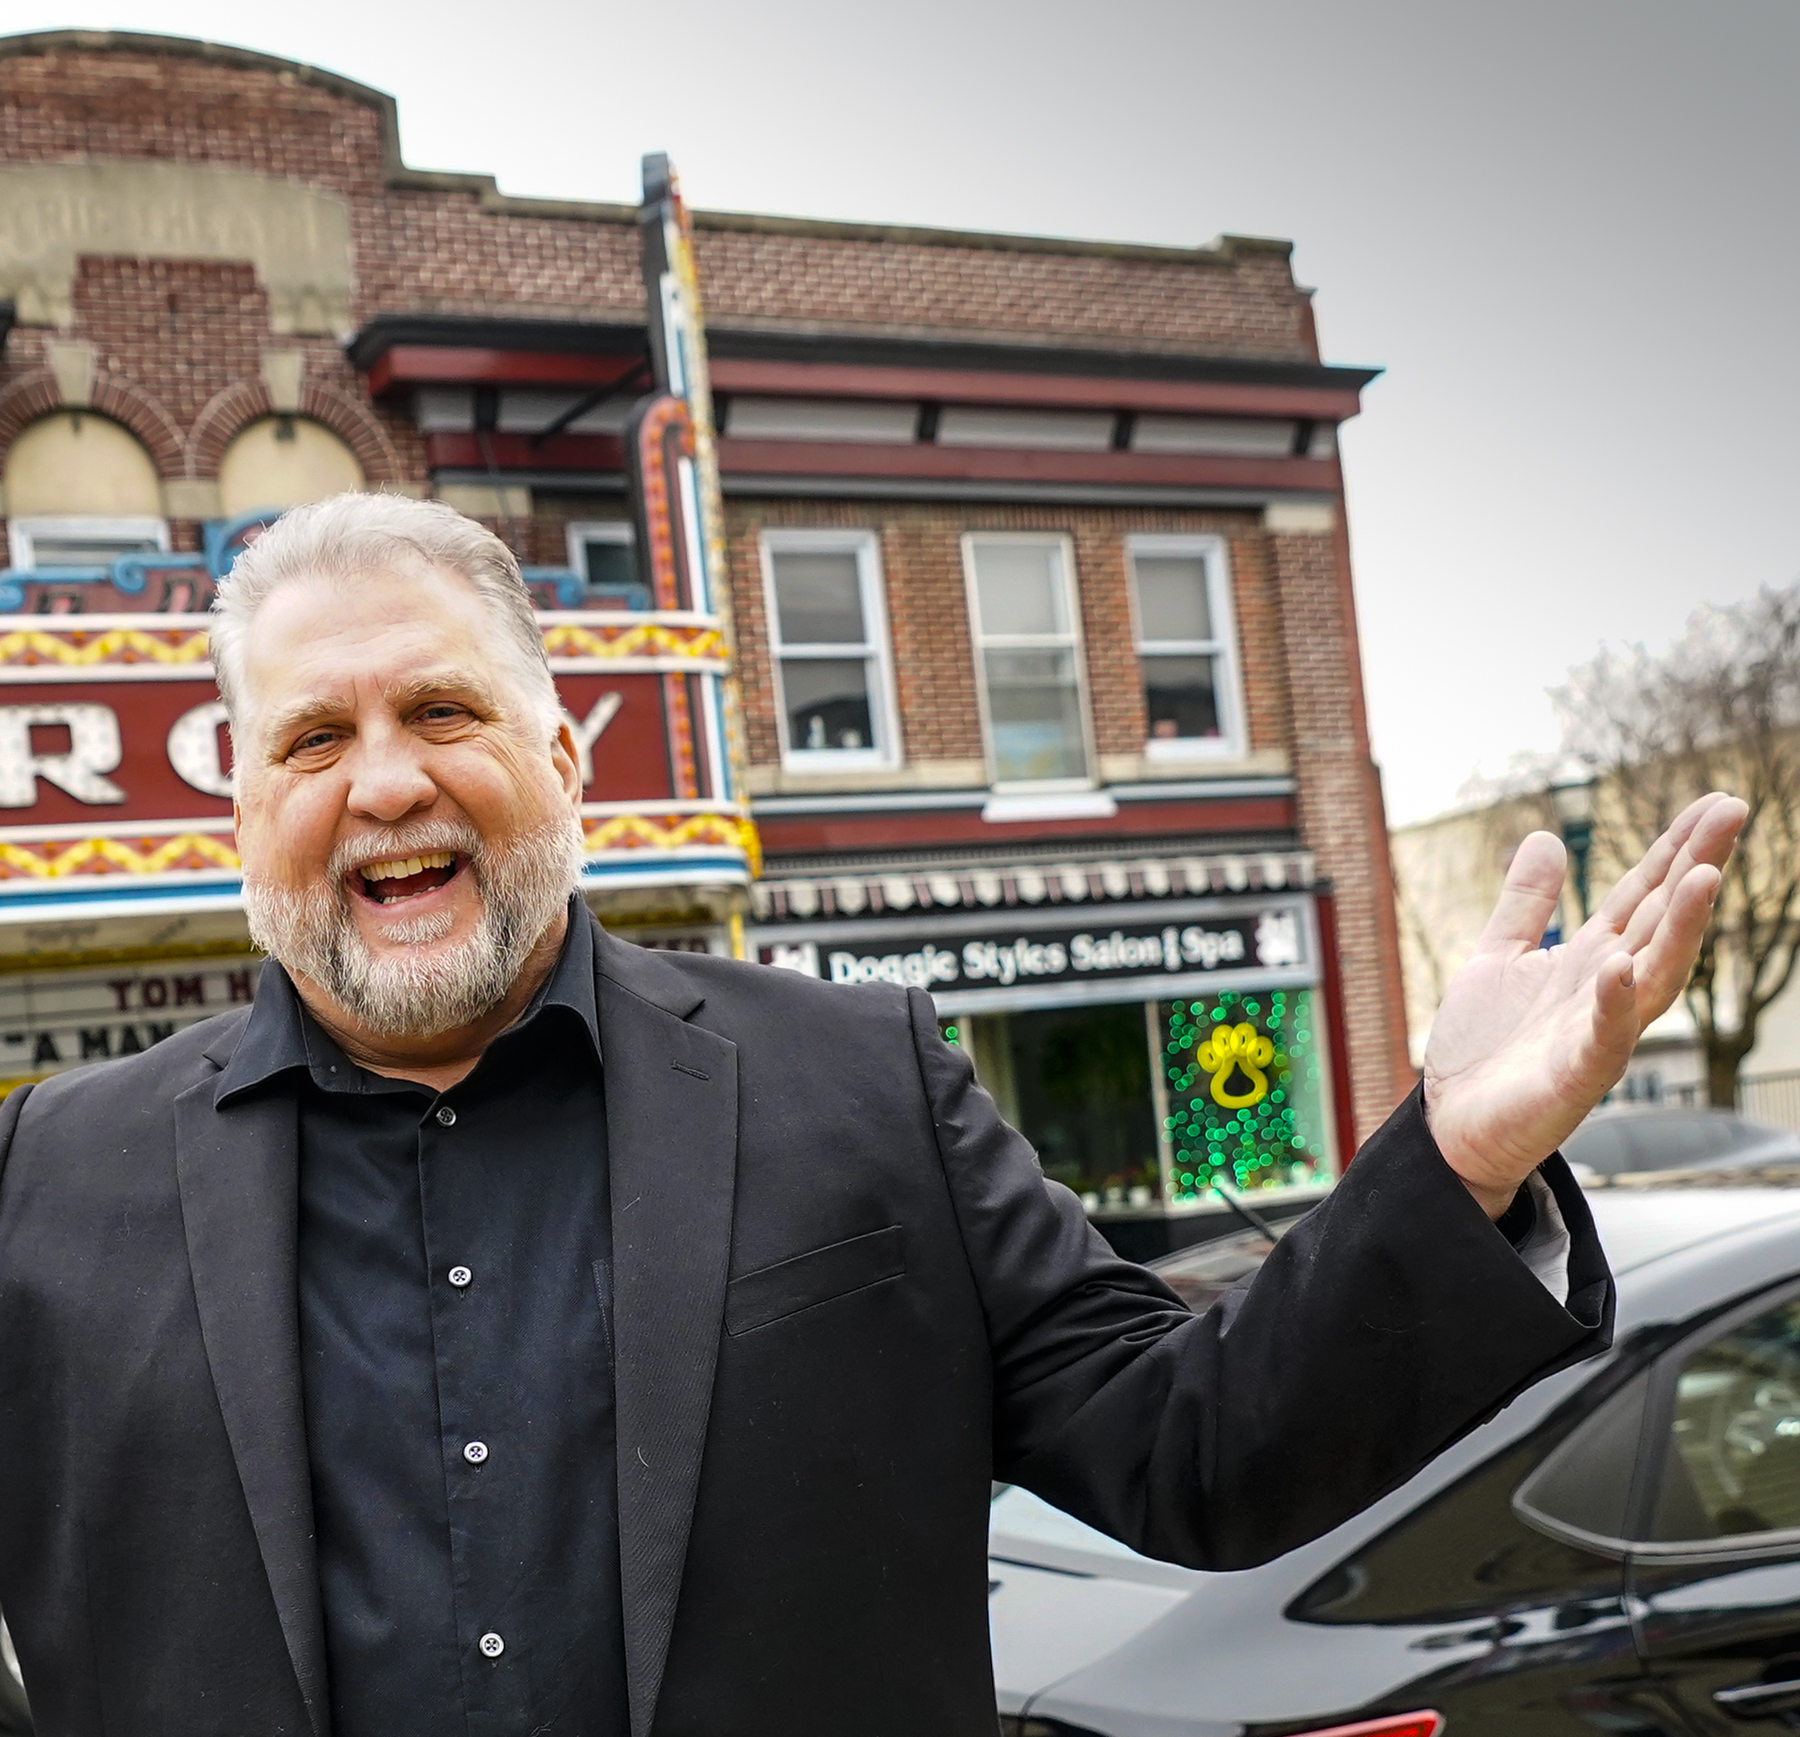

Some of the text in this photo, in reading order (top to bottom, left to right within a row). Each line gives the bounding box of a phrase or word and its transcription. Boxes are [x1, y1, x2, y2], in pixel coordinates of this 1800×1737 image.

[828, 943, 960, 990] Doggie
[962, 936, 1068, 985] Styles
[1070, 930, 1163, 972] Salon
[1181, 925, 1245, 970] Spa
[107, 973, 205, 1012] TOM
